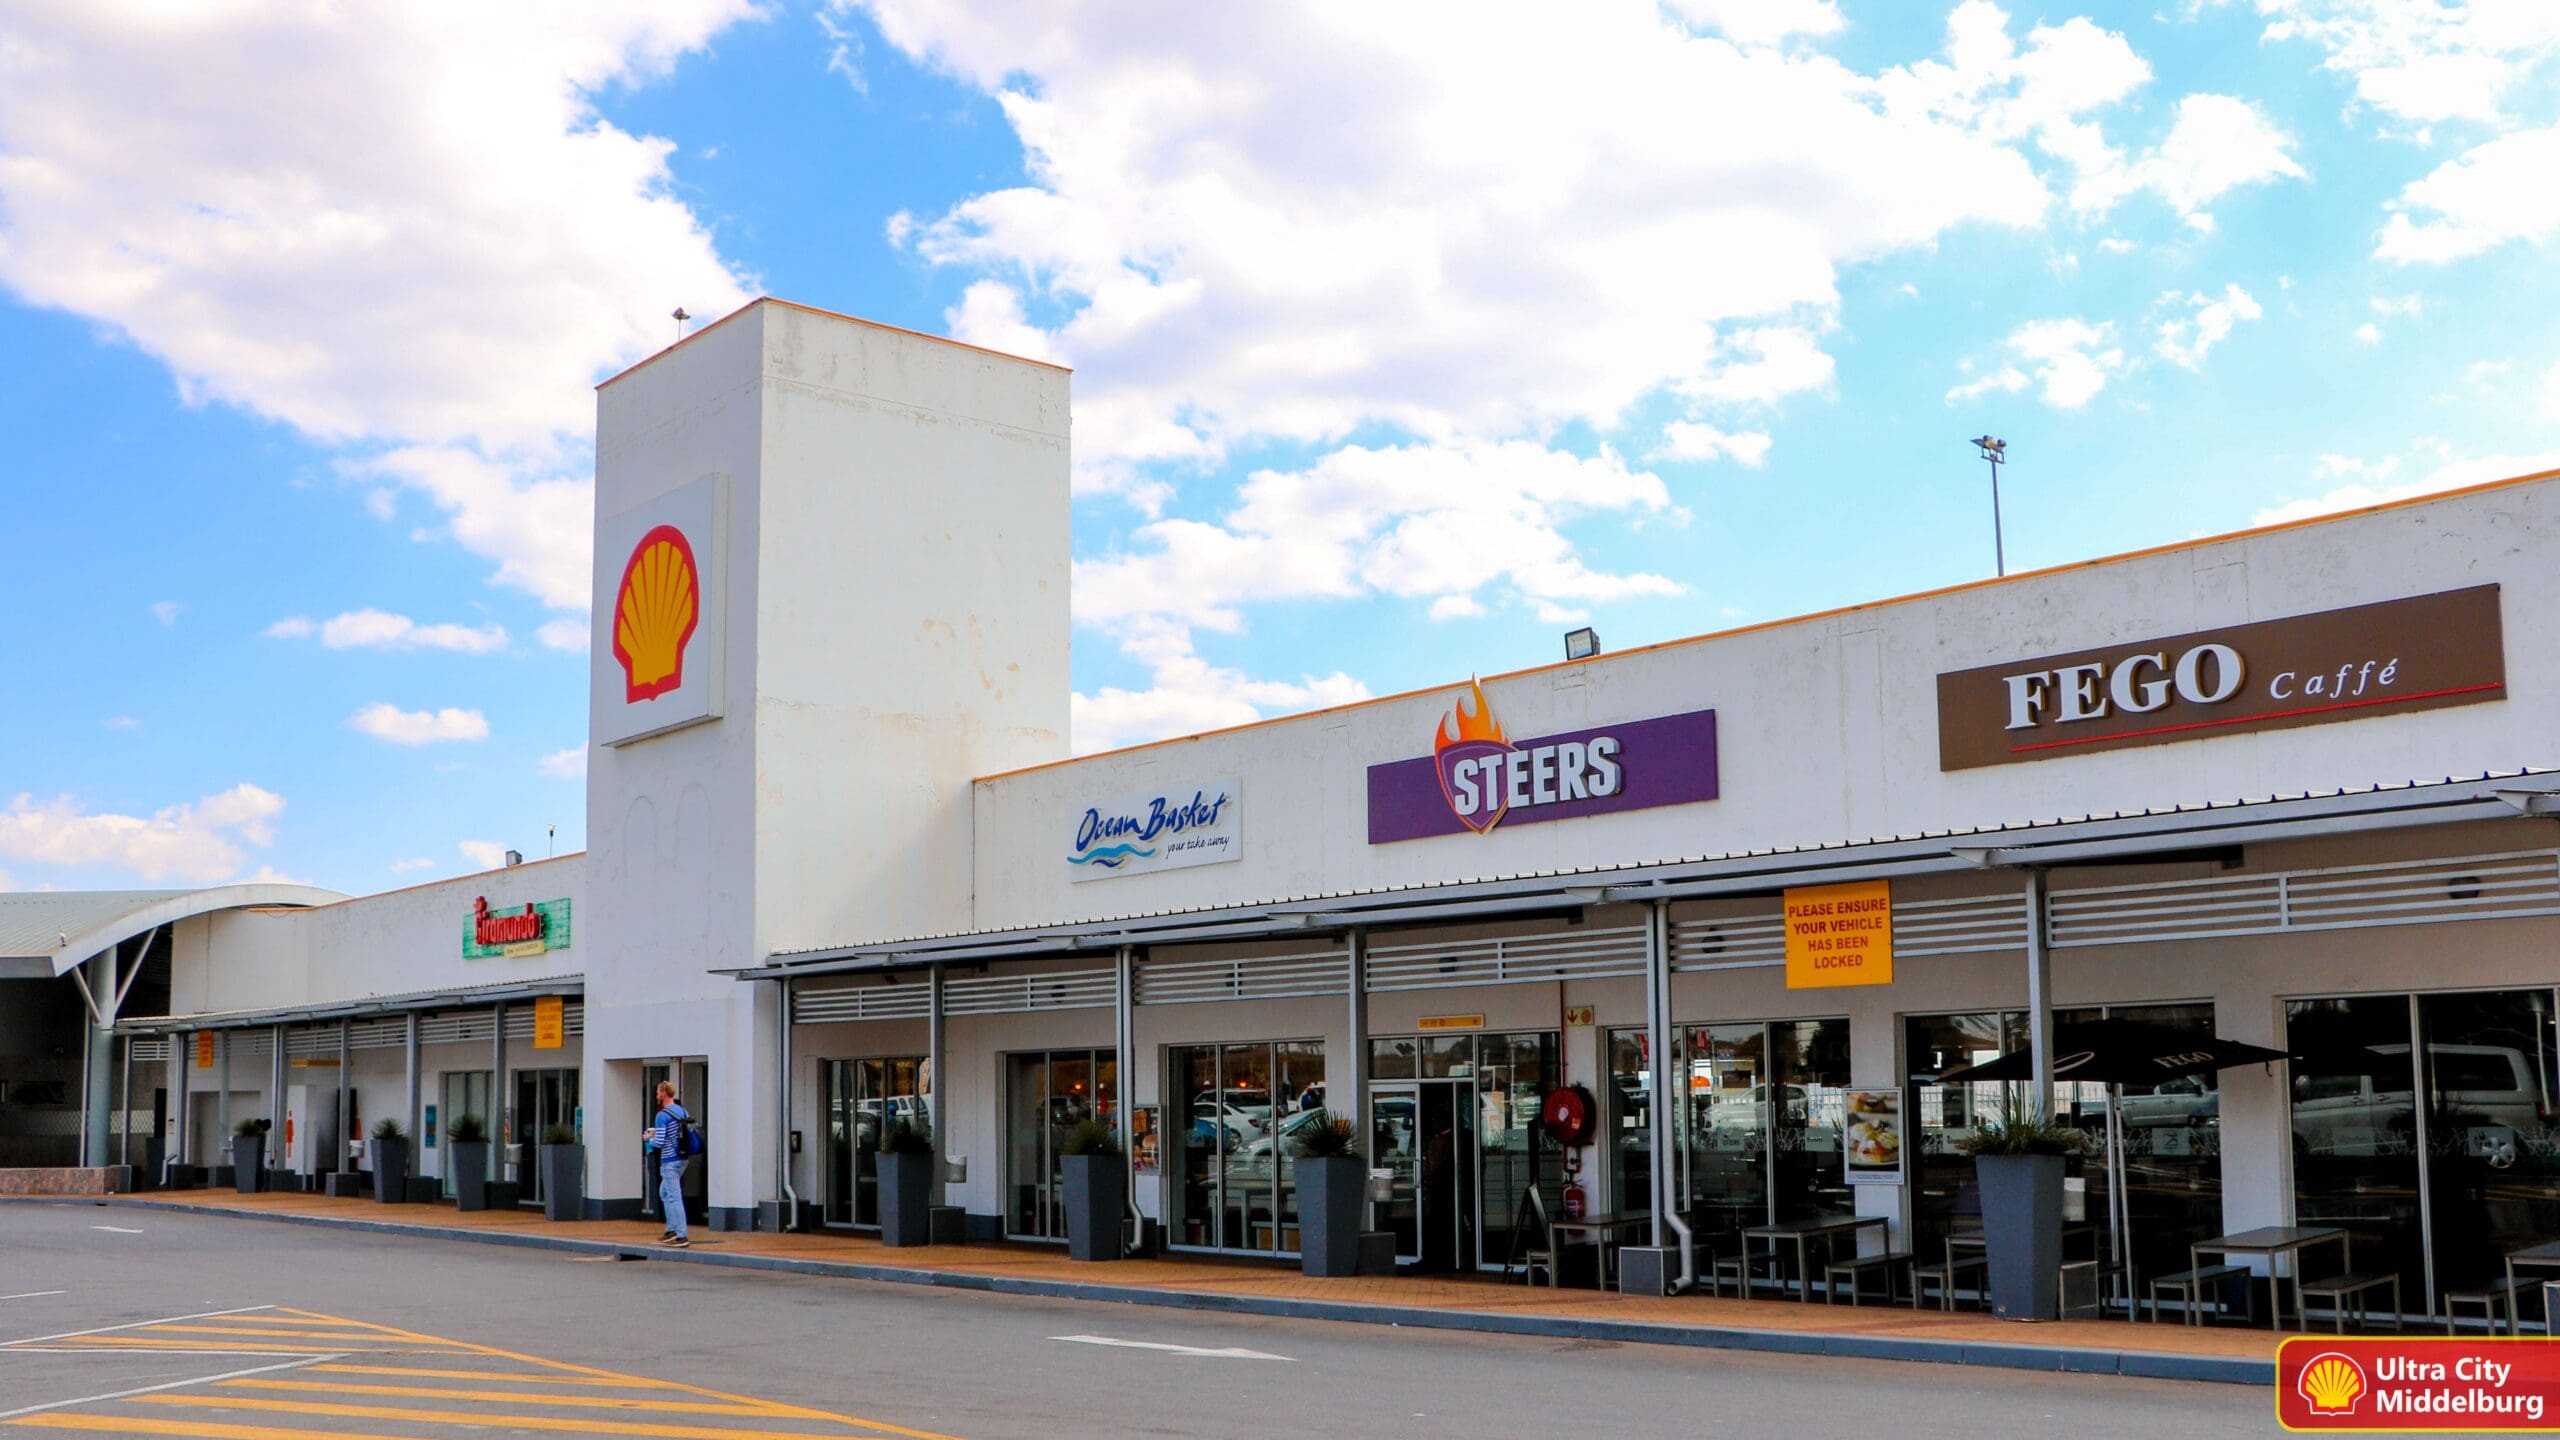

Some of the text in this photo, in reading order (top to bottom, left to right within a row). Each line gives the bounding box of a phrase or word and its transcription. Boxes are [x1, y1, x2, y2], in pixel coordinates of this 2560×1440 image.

[2002, 643, 2400, 731] FEGO Caffé
[1453, 736, 1621, 816] STEERS
[1076, 790, 1227, 852] Ocean Basket
[1165, 835, 1230, 860] your take away
[1788, 898, 1887, 918] PLEASE ENSURE
[1793, 917, 1883, 935] YOUR VEHICLE
[1808, 936, 1869, 952] HAS BEEN
[1814, 955, 1863, 969] LOCKED
[2152, 1051, 2215, 1068] FEGO
